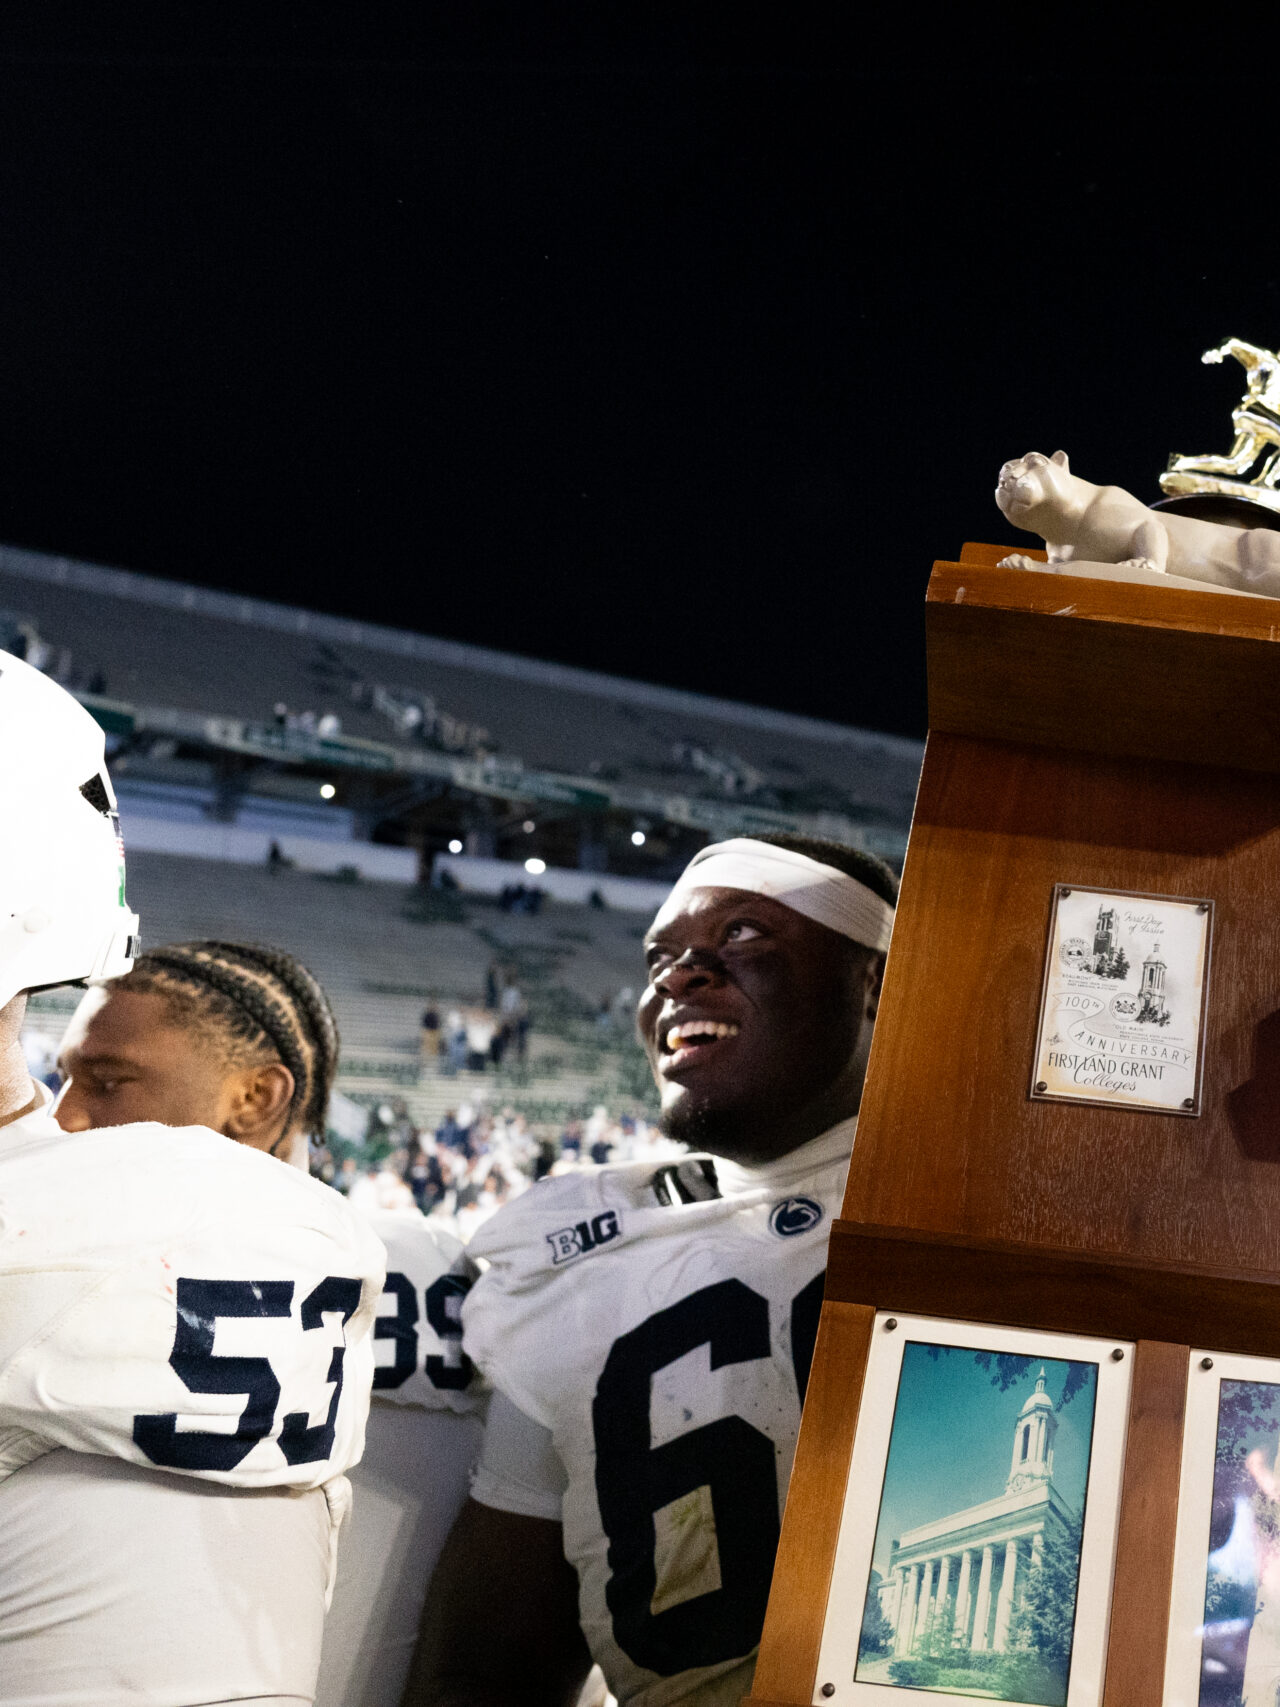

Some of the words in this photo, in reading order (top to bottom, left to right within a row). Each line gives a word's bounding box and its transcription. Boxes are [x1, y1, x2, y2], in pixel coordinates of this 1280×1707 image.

[1074, 1030, 1191, 1064] ANNIVERSARY
[1048, 1051, 1080, 1070] FIRST
[1083, 1057, 1117, 1075] LAND
[1120, 1061, 1166, 1081] GRANT
[1074, 1058, 1137, 1094] Colleges
[133, 1276, 363, 1471] 53
